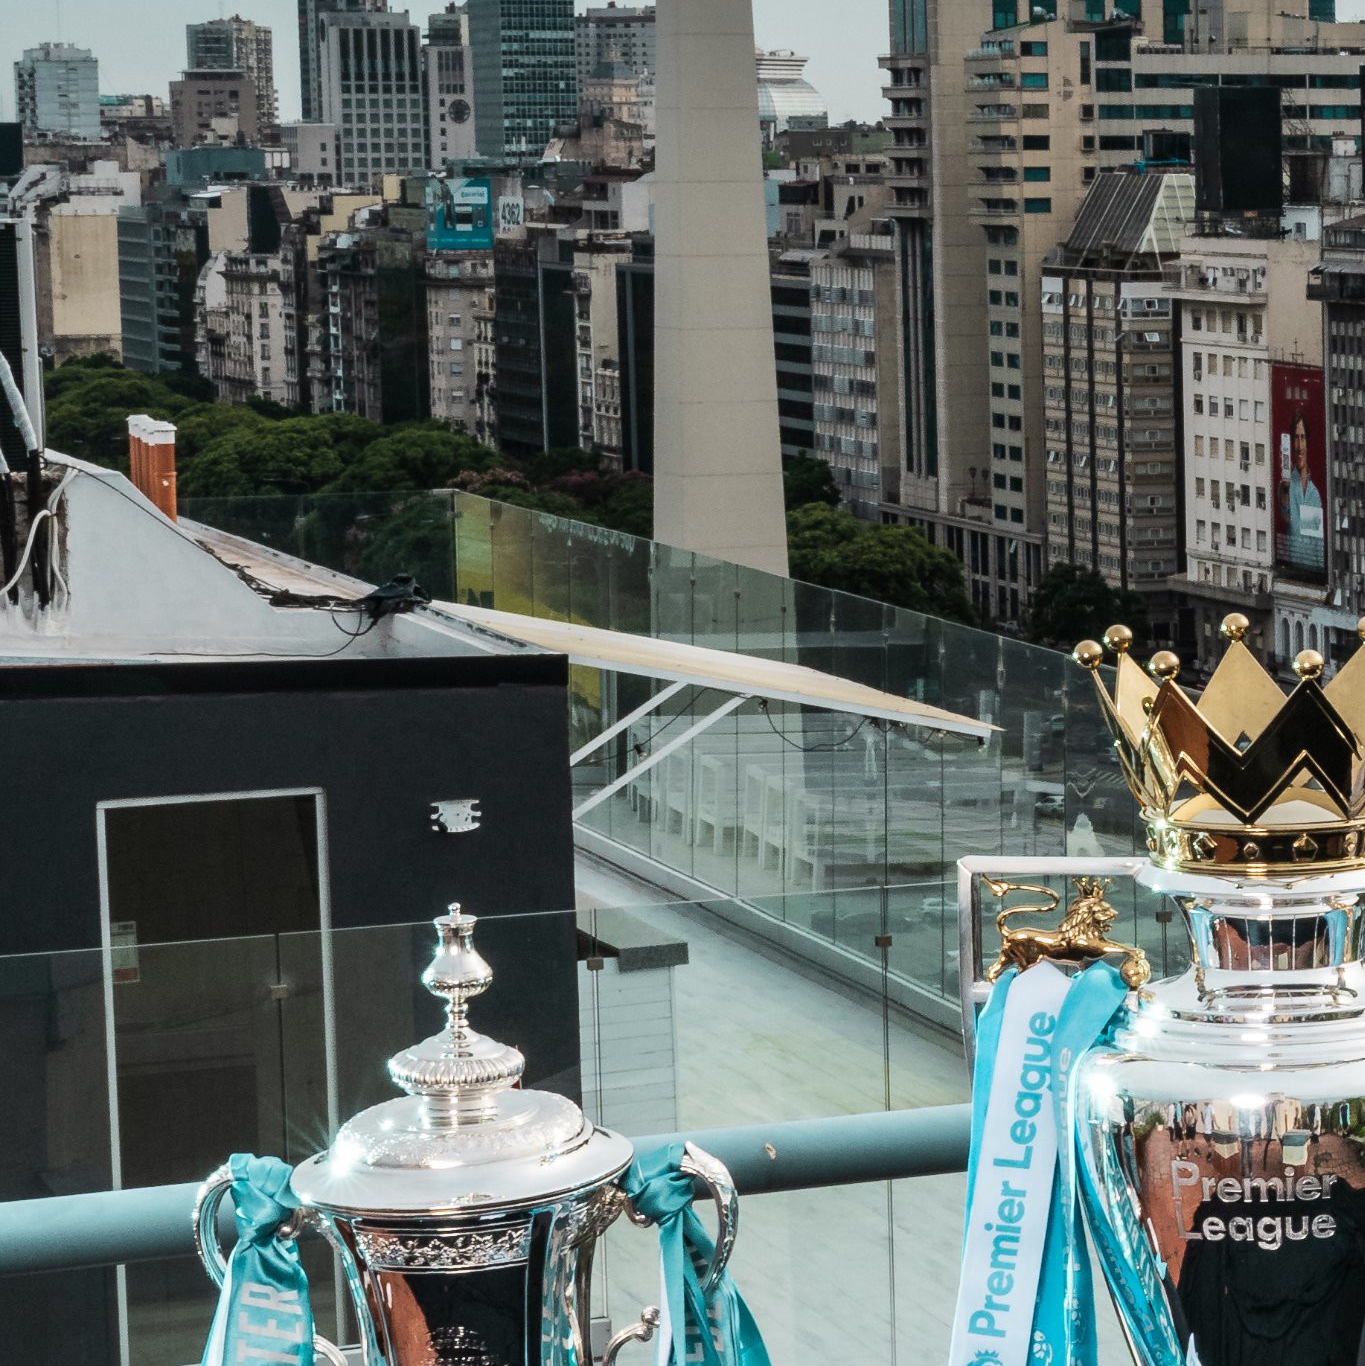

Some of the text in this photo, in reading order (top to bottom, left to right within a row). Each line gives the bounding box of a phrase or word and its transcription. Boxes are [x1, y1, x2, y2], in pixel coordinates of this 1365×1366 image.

[968, 1011, 1057, 1338] Premier League
[1170, 1158, 1339, 1204] Premier
[1172, 1199, 1338, 1251] League
